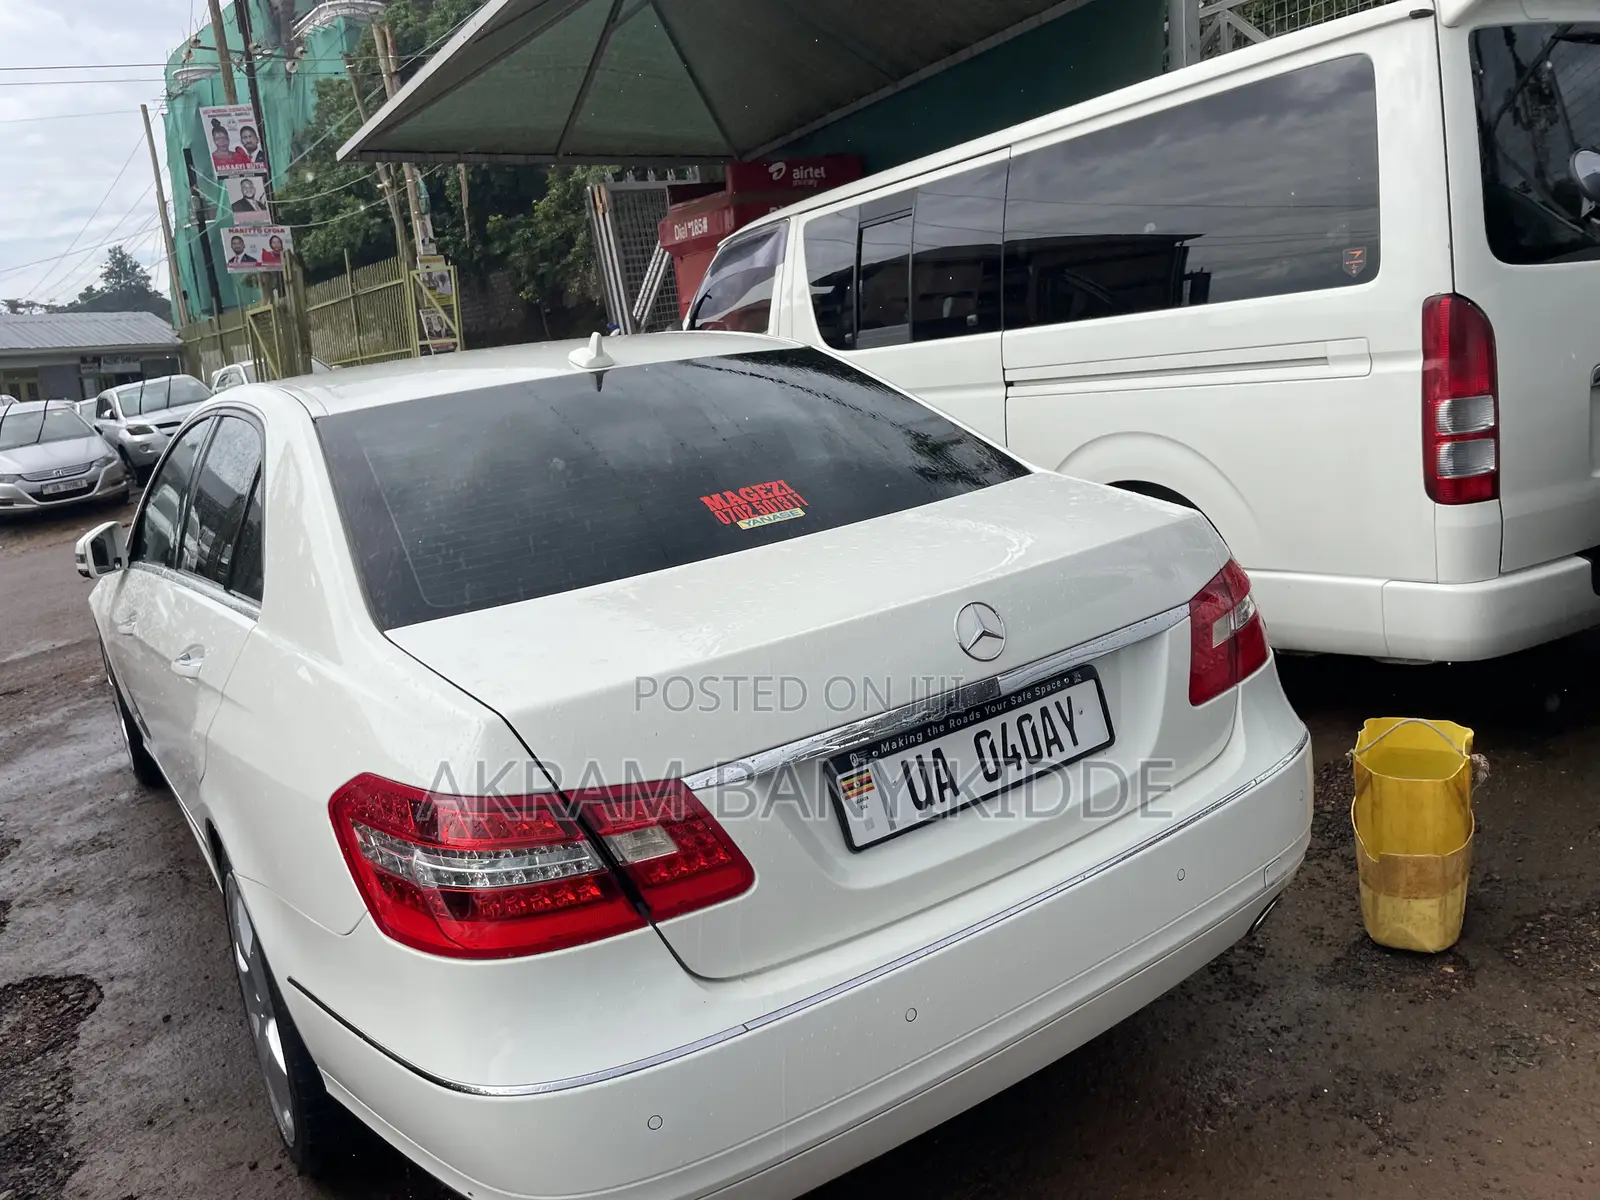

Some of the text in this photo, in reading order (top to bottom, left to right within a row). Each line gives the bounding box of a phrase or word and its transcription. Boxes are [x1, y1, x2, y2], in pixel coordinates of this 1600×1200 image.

[792, 166, 827, 179] airtel
[674, 222, 688, 240] Dial
[700, 480, 795, 511] MAGEZI
[714, 505, 759, 525] 0702
[743, 510, 800, 527] YANASE
[881, 680, 1062, 753] Making the Roads Your Safe Space
[901, 696, 1079, 811] UA 040AY
